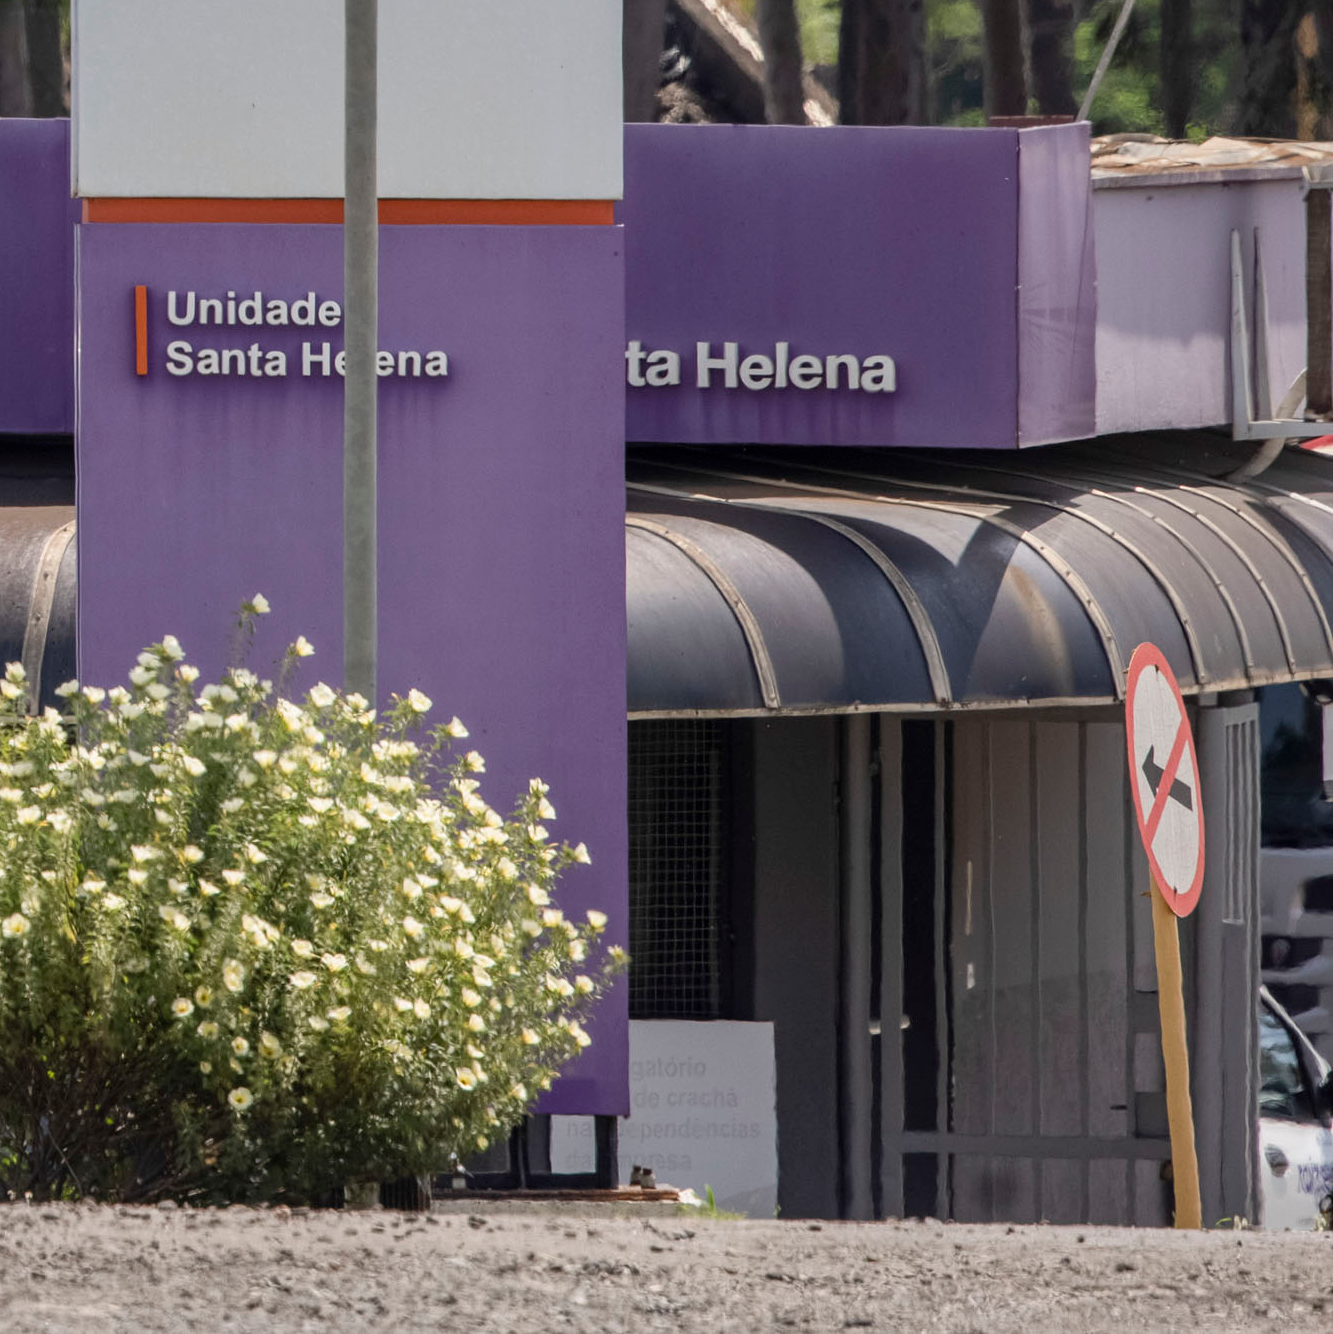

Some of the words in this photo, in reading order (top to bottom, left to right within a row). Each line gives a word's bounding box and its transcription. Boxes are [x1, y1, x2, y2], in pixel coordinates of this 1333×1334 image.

[166, 290, 341, 327] Unidade
[165, 341, 287, 377] Santa
[302, 341, 448, 378] Hena
[625, 340, 681, 387] ta
[696, 341, 896, 393] Helena
[631, 1056, 707, 1082] gatório
[633, 1087, 660, 1108] de
[619, 1153, 692, 1171] mpresa
